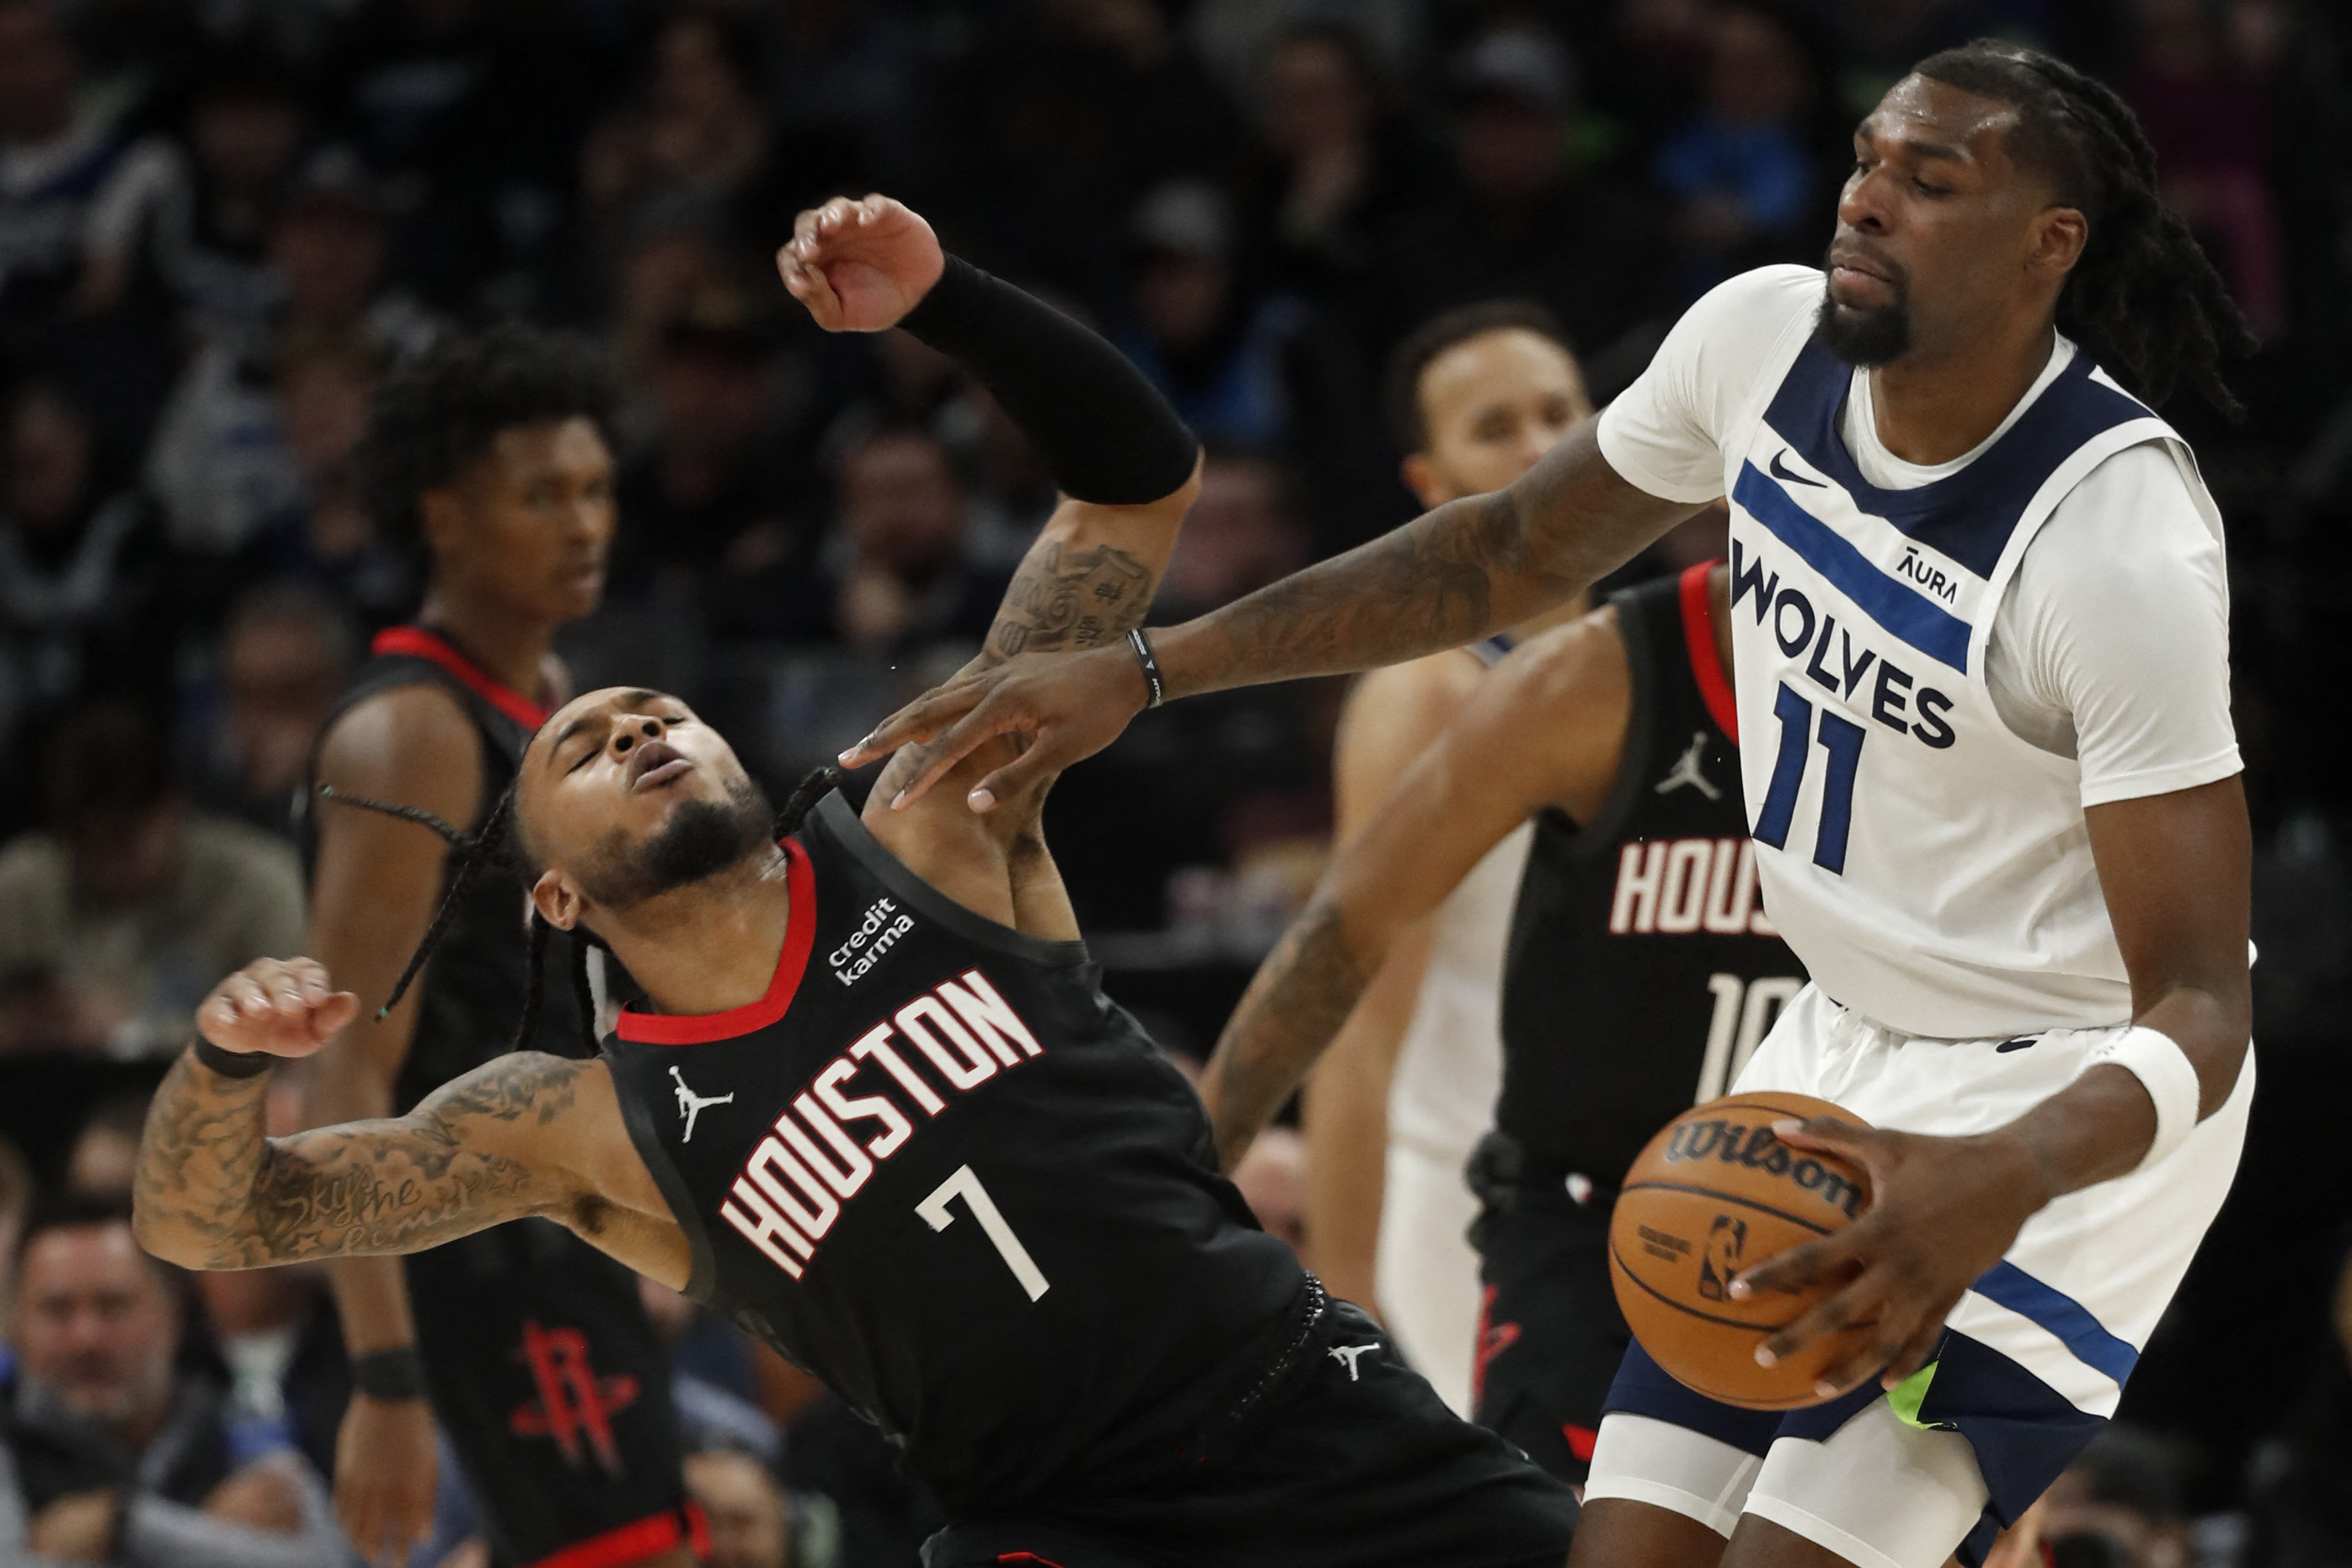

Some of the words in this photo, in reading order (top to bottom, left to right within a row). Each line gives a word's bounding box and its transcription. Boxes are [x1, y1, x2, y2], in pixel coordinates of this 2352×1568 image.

[1730, 537, 1956, 749] WOLVES
[1751, 680, 1867, 876] 11
[828, 897, 896, 968] credit
[835, 914, 915, 987] karma
[719, 967, 1045, 1282] HOUSTON
[1664, 1120, 1863, 1220] Wilson
[915, 1164, 1050, 1303] 7
